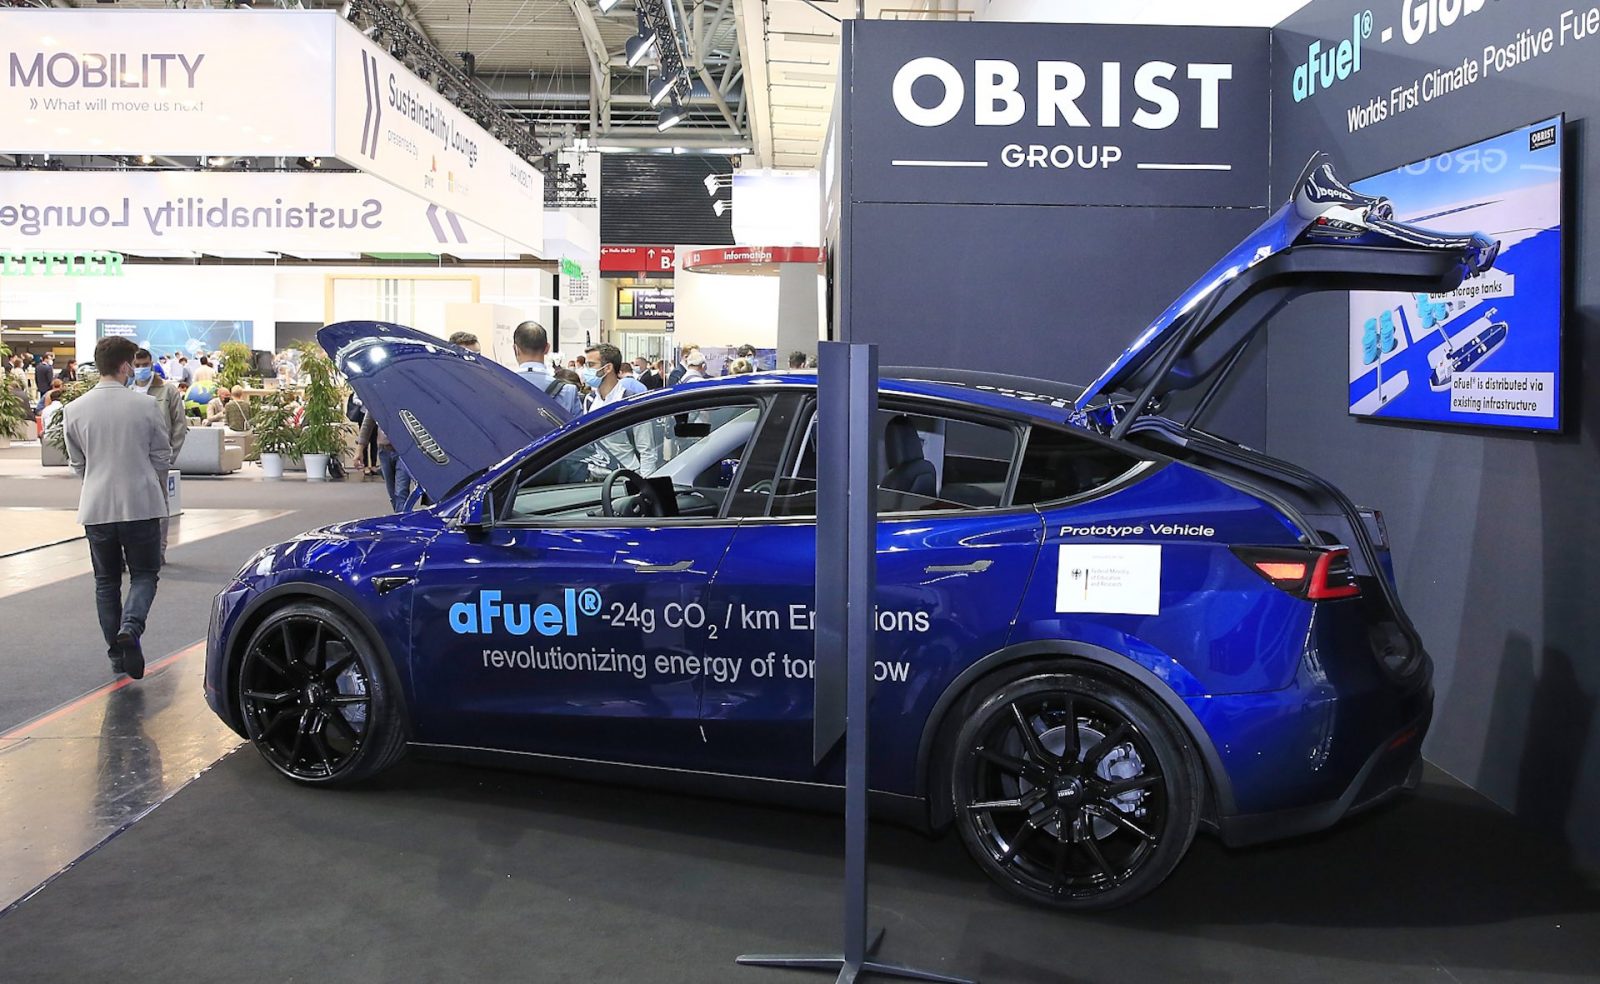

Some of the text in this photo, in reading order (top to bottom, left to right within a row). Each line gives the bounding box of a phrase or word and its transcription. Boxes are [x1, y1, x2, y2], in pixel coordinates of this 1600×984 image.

[1401, 0, 1486, 45] Glo
[9, 52, 206, 89] MOBILITY
[1347, 7, 1600, 133] Worlds First Climate Positive Fue
[43, 97, 204, 112] What will move us next
[892, 56, 1233, 130] OBRIST
[388, 72, 478, 169] Sustainability Lounge
[1531, 127, 1555, 143] OBRIST
[1000, 143, 1122, 169] GROUP
[723, 250, 772, 261] Information
[1482, 280, 1502, 294] tanks
[1477, 377, 1483, 390] is
[1485, 377, 1528, 391] distributed
[1530, 378, 1544, 391] via
[1453, 395, 1537, 411] existing infrastructure
[1059, 523, 1215, 537] Prototype Vehicle
[724, 603, 733, 630] /
[741, 603, 780, 630] km
[482, 645, 647, 679] revolutionizing
[654, 654, 742, 683] energy
[750, 652, 776, 678] of
